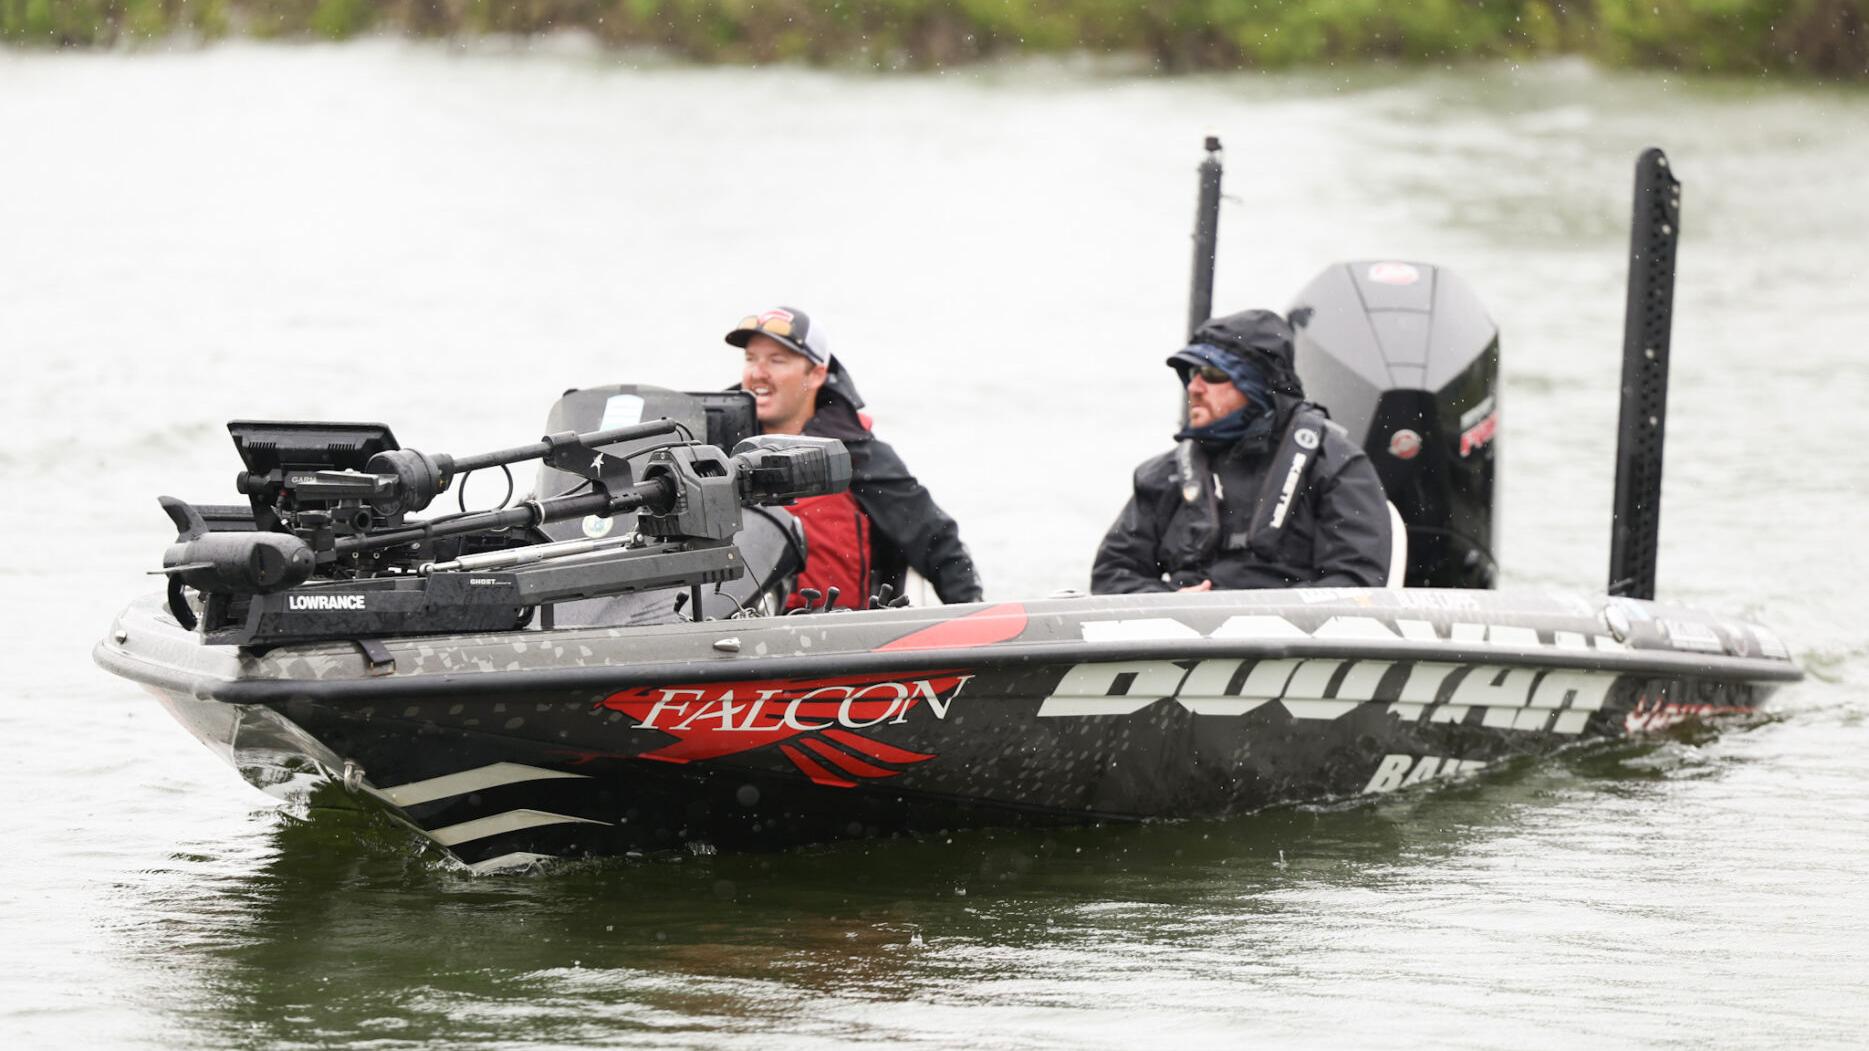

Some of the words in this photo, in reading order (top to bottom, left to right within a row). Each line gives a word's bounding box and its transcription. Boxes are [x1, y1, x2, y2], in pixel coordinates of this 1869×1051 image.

[291, 476, 317, 484] GARM
[288, 595, 367, 611] LOWRANCE
[631, 674, 976, 732] FALCON
